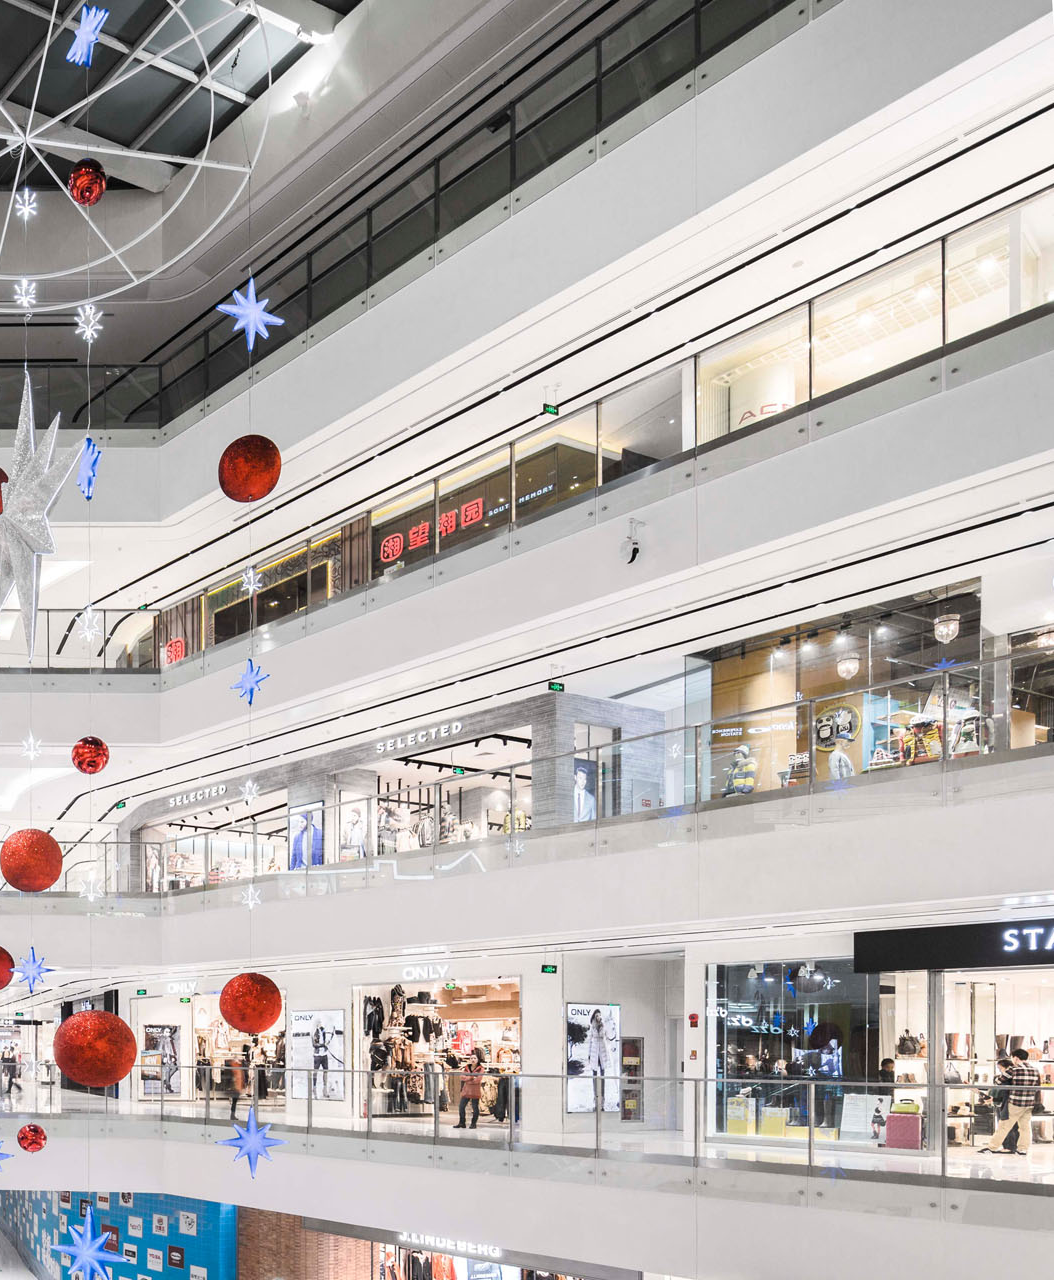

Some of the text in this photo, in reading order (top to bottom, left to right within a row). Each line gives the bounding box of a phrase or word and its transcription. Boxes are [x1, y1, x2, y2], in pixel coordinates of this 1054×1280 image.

[488, 484, 553, 517] SOUT MEMORY
[408, 497, 483, 550] 望湘园
[376, 722, 463, 753] SELECTED
[169, 785, 228, 807] SELECTED
[402, 965, 448, 980] ONLY
[168, 982, 197, 993] ONLY
[399, 1231, 502, 1258] J.LINDEBERG
